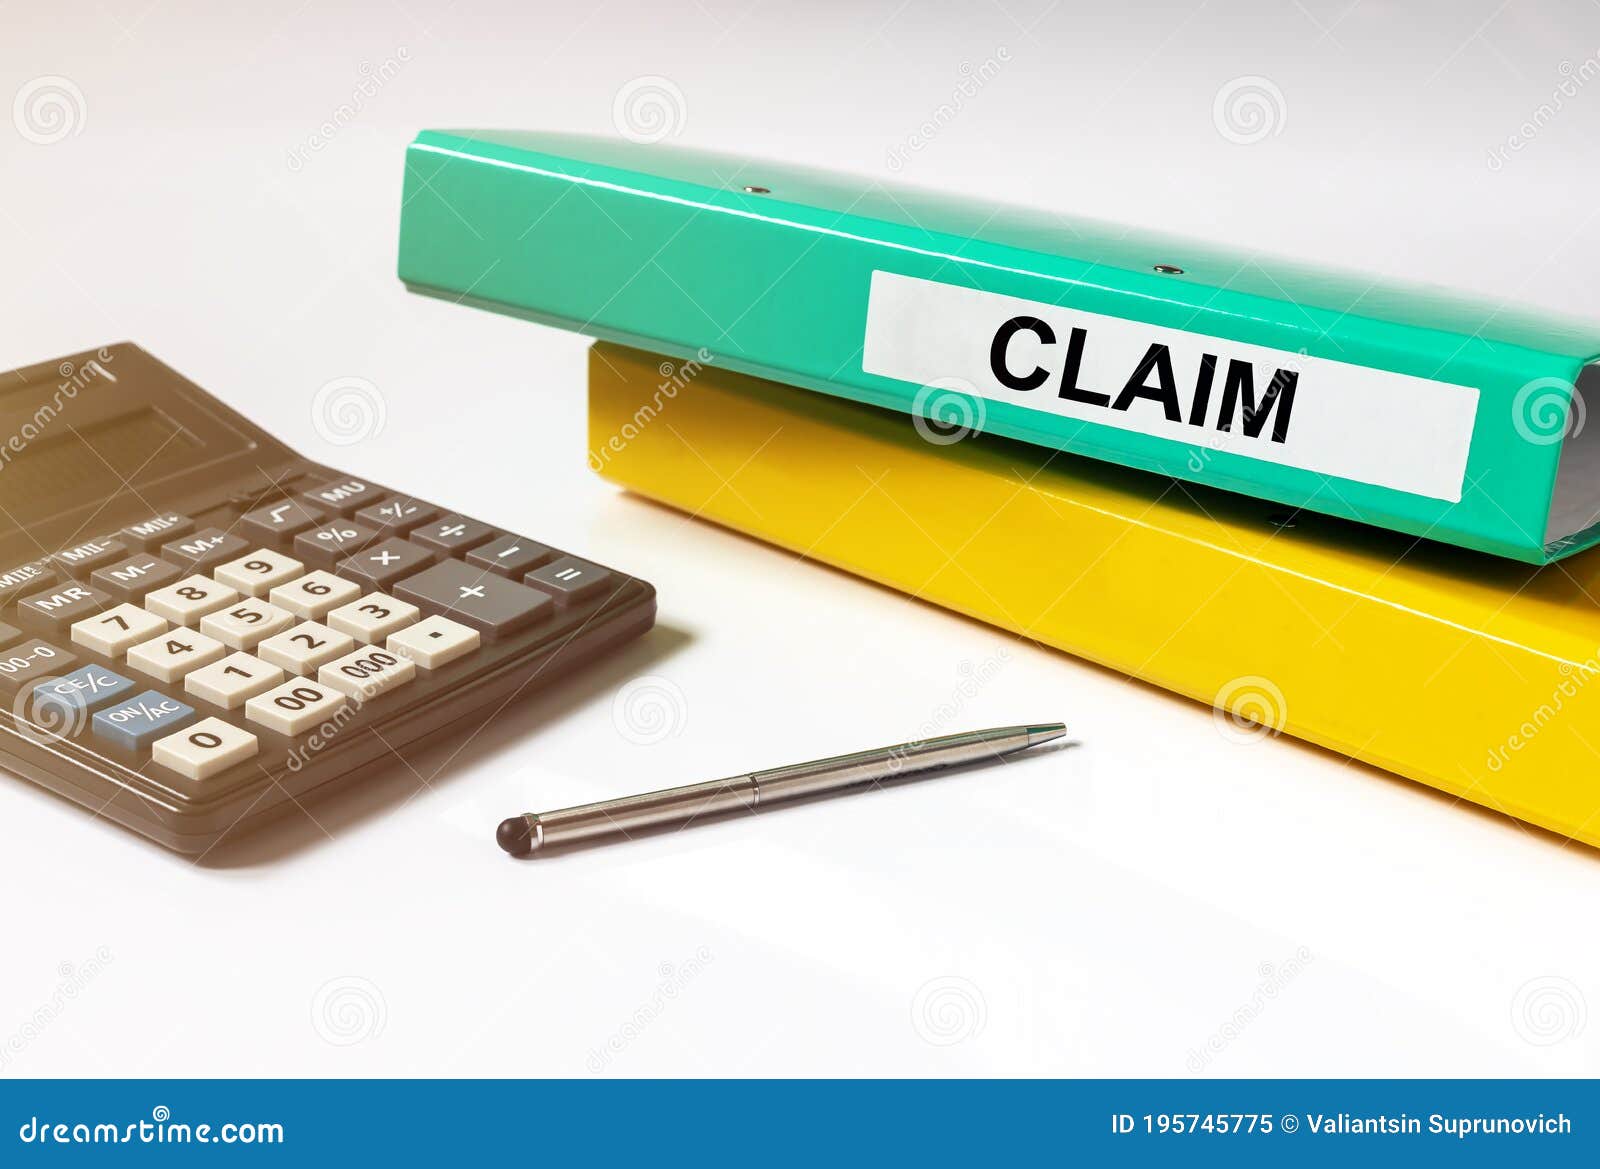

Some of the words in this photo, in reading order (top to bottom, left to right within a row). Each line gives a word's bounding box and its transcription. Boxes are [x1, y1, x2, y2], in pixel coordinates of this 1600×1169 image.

[989, 315, 1300, 444] CLAIM
[320, 481, 367, 503] MU
[179, 534, 225, 554] M+
[243, 560, 274, 574] 9
[175, 586, 209, 601] 8
[301, 581, 332, 596] 6
[35, 587, 92, 610] MR
[229, 607, 263, 624] 5
[358, 604, 391, 619] 3
[101, 615, 131, 632] 7
[167, 639, 194, 656] 4
[290, 634, 327, 650] 2
[223, 665, 253, 679] 1
[339, 652, 399, 679] 000
[54, 671, 119, 693] CE/C
[273, 687, 324, 711] 00
[108, 701, 181, 722] ON/AC
[188, 732, 223, 749] 0
